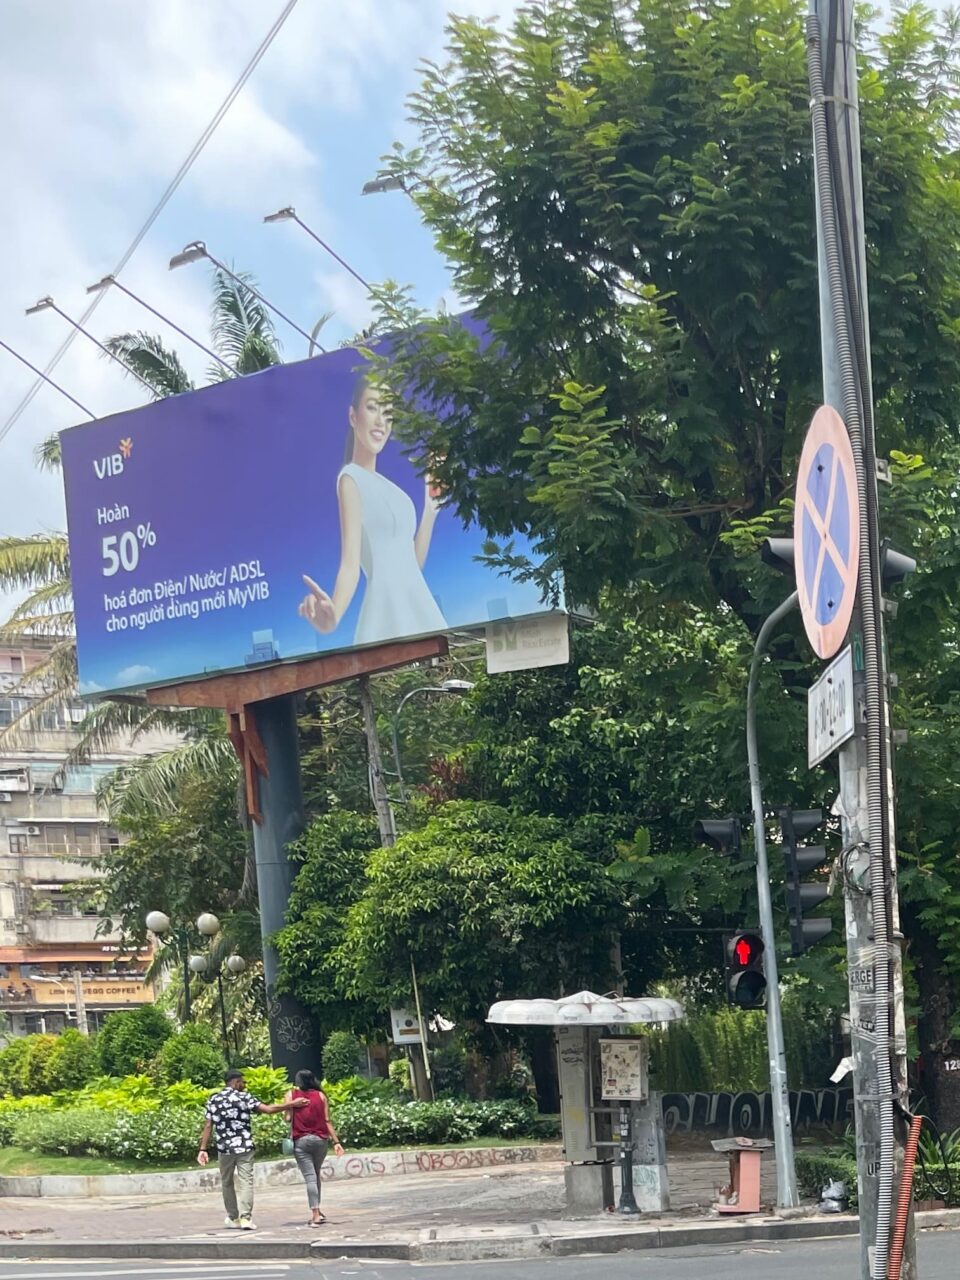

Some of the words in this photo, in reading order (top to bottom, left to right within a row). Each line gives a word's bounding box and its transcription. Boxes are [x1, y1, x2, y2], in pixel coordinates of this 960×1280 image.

[93, 453, 124, 480] VIB
[97, 503, 130, 525] Hoàn
[102, 522, 157, 576] 50%
[104, 590, 127, 611] hoá
[129, 586, 153, 606] đơn
[230, 560, 265, 584] ADSL
[106, 614, 128, 632] cho
[130, 605, 165, 631] người
[167, 598, 199, 619] dùng
[202, 591, 226, 612] mới
[228, 581, 270, 608] MyVIB
[106, 987, 137, 995] COFFEE
